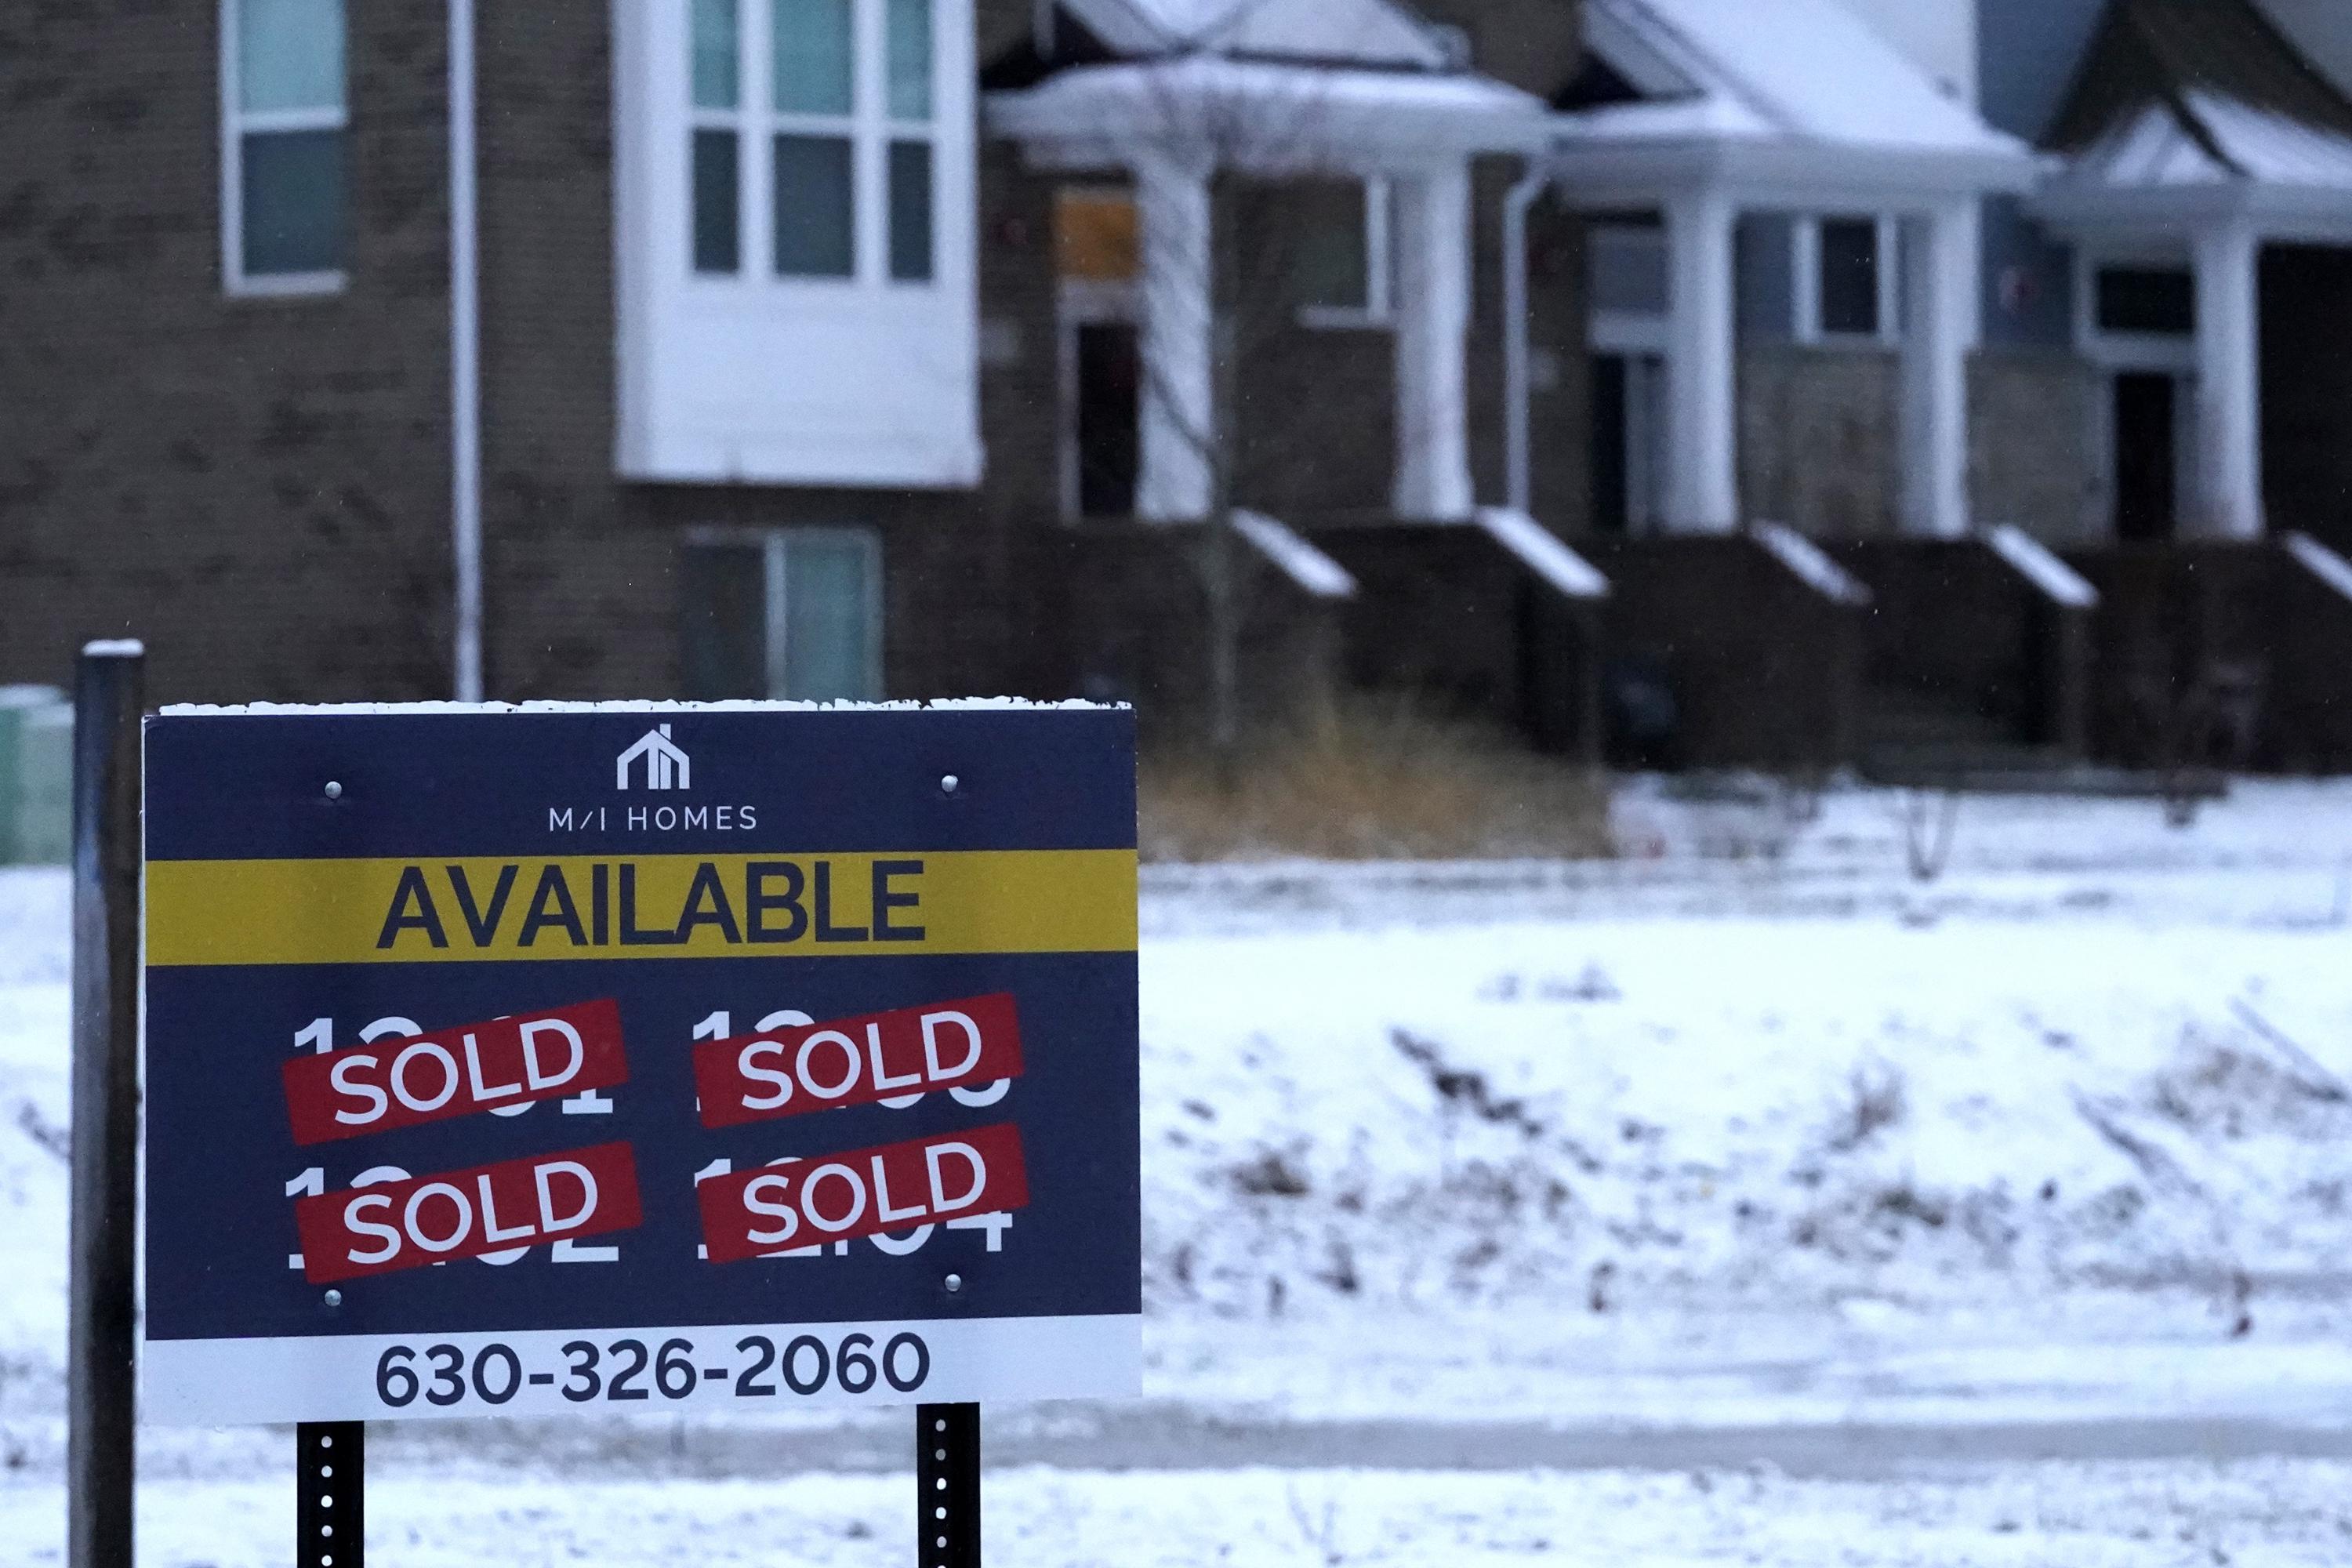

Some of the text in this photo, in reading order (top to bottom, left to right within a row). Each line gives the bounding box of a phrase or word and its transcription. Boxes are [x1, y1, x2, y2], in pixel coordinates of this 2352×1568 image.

[550, 806, 757, 832] M/I HOMES
[376, 859, 927, 949] AVAILABLE
[330, 1018, 583, 1125] SOLD
[738, 1011, 982, 1110] SOLD
[343, 1160, 598, 1265] SOLD
[742, 1142, 987, 1244] SOLD
[376, 1332, 931, 1408] 630-326-2060
